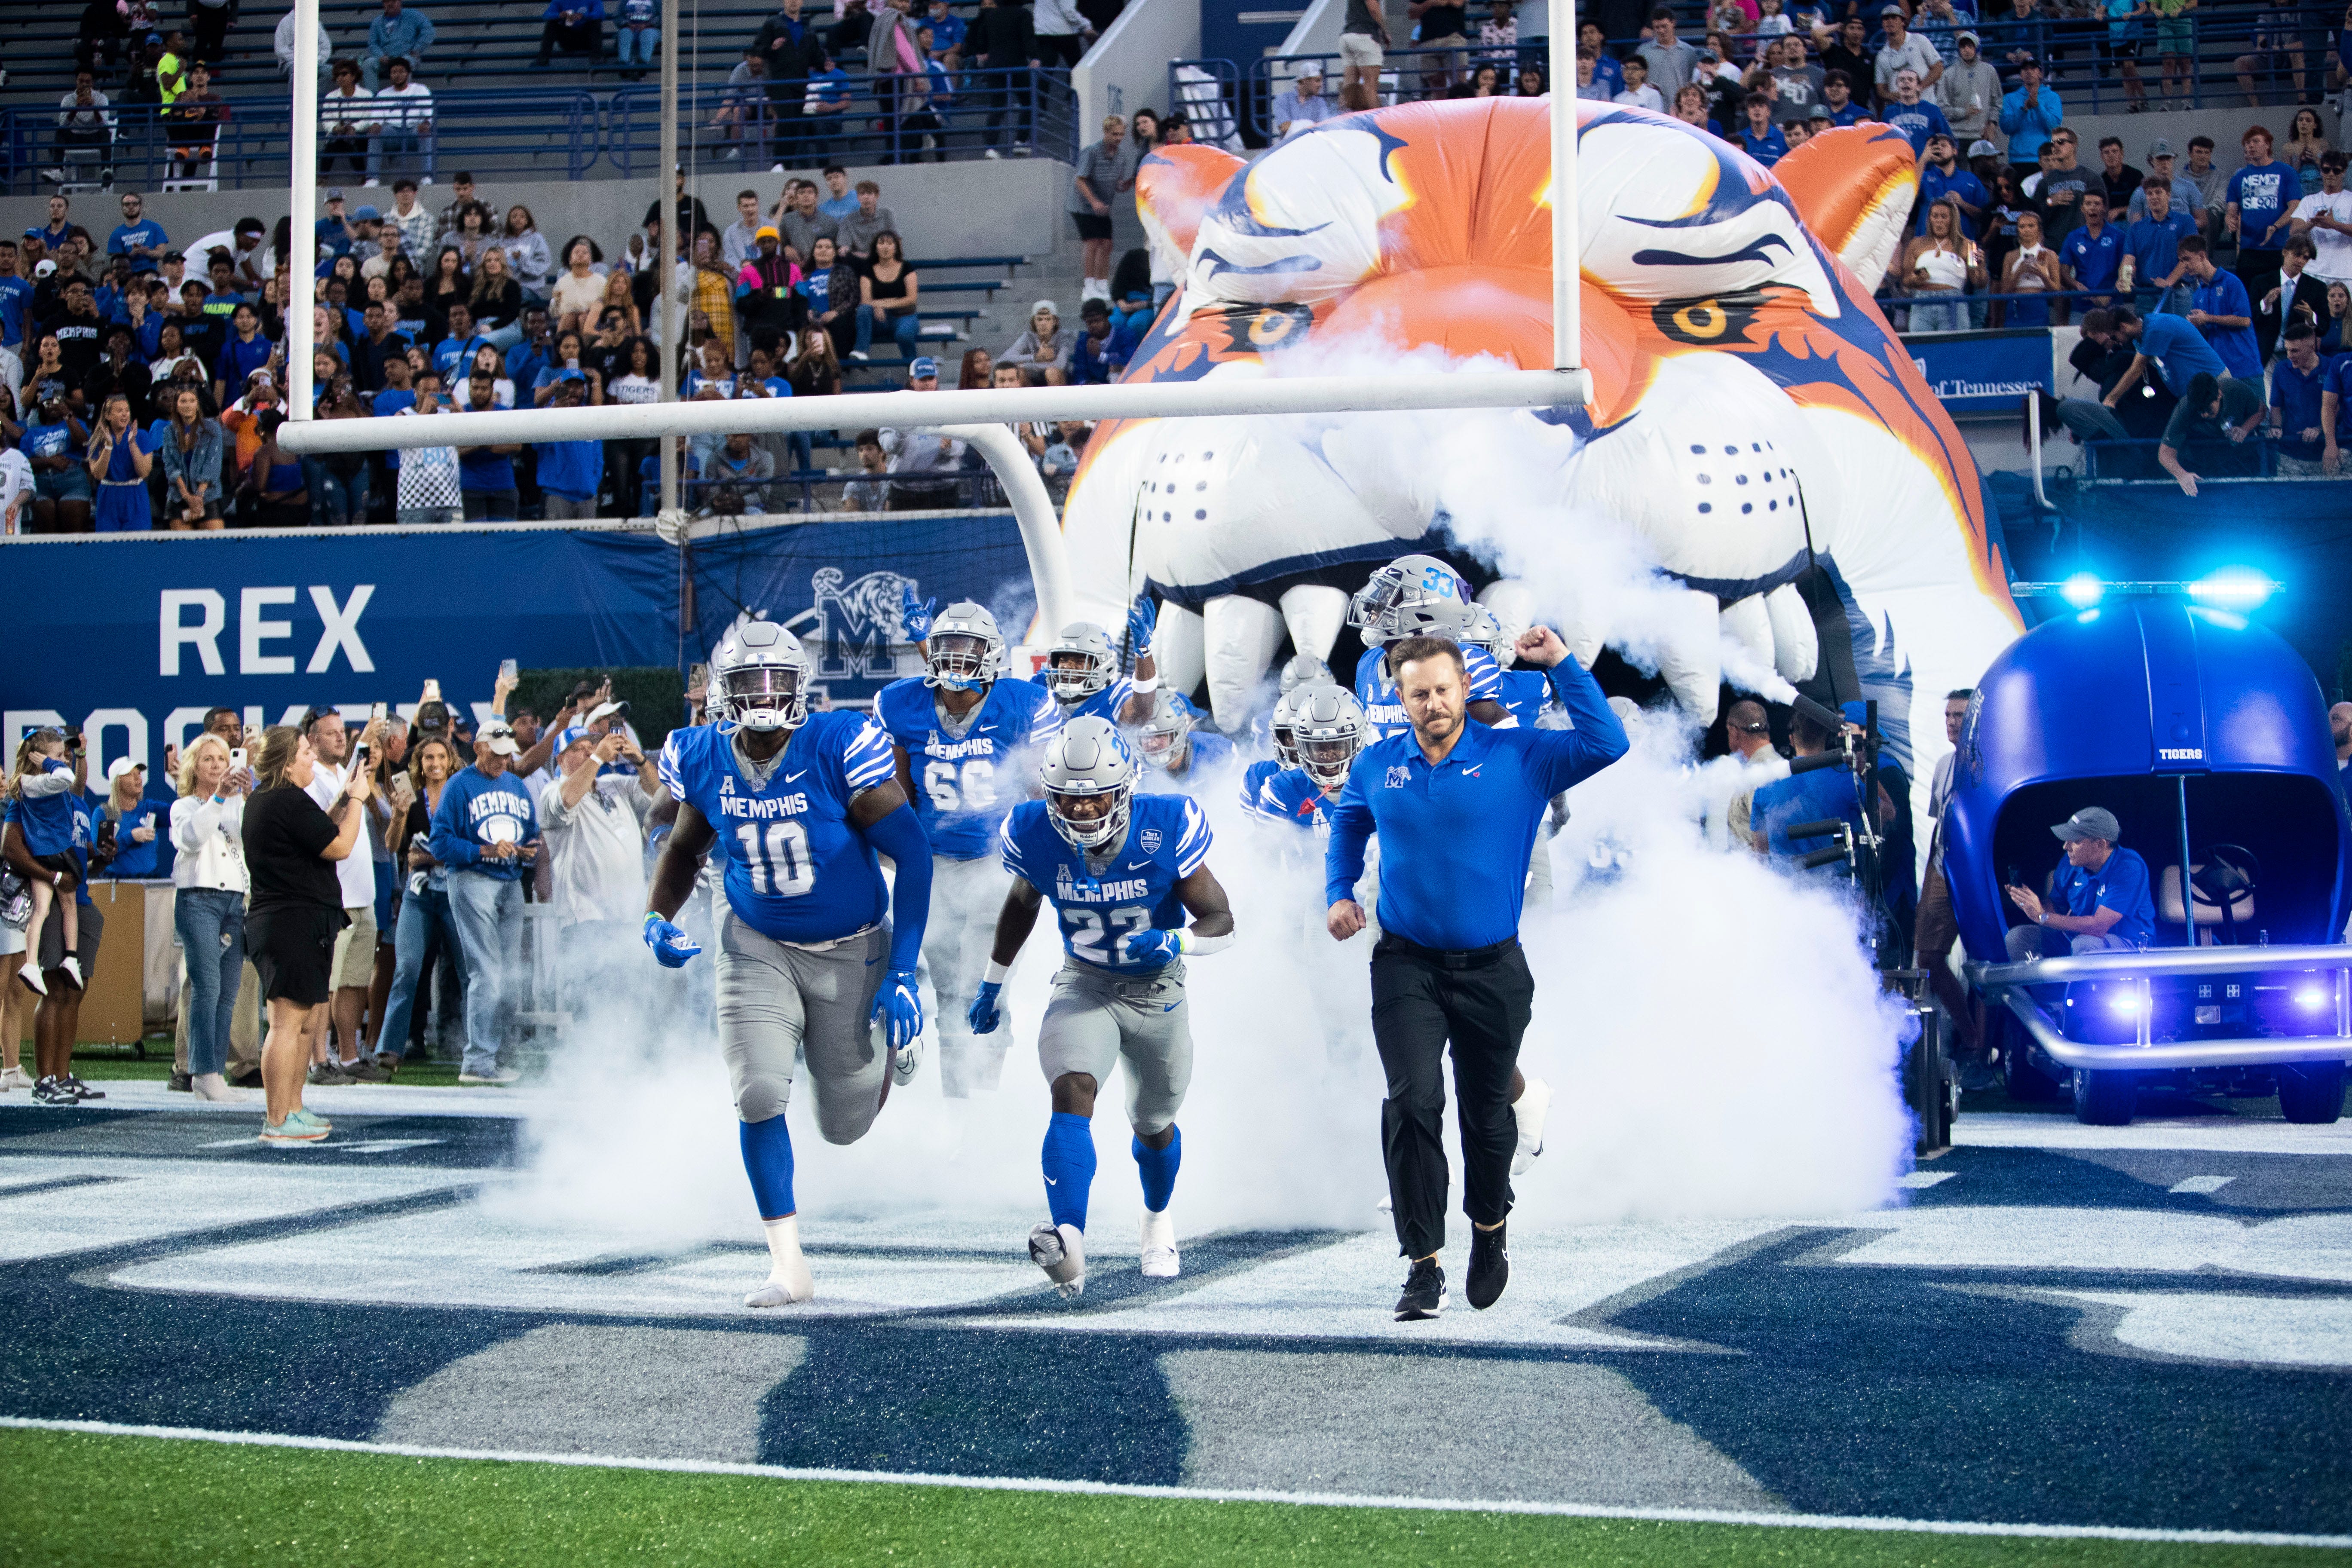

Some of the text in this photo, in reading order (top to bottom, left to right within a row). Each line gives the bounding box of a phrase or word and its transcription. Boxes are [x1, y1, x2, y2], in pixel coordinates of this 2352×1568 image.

[56, 326, 98, 342] MEMPHIS
[621, 385, 655, 394] TIGERS
[1422, 567, 1455, 598] 33
[160, 584, 376, 677] REX
[1366, 703, 1410, 723] EMPHIS
[925, 738, 994, 760] MEMPHIS
[2159, 748, 2203, 760] TIGERS
[924, 759, 998, 812] 66
[469, 790, 530, 825] MEMPHIS
[720, 792, 808, 818] MEMPHIS
[231, 847, 250, 890] GO TIGERS
[735, 818, 817, 897] 10
[1061, 902, 1153, 965] 22
